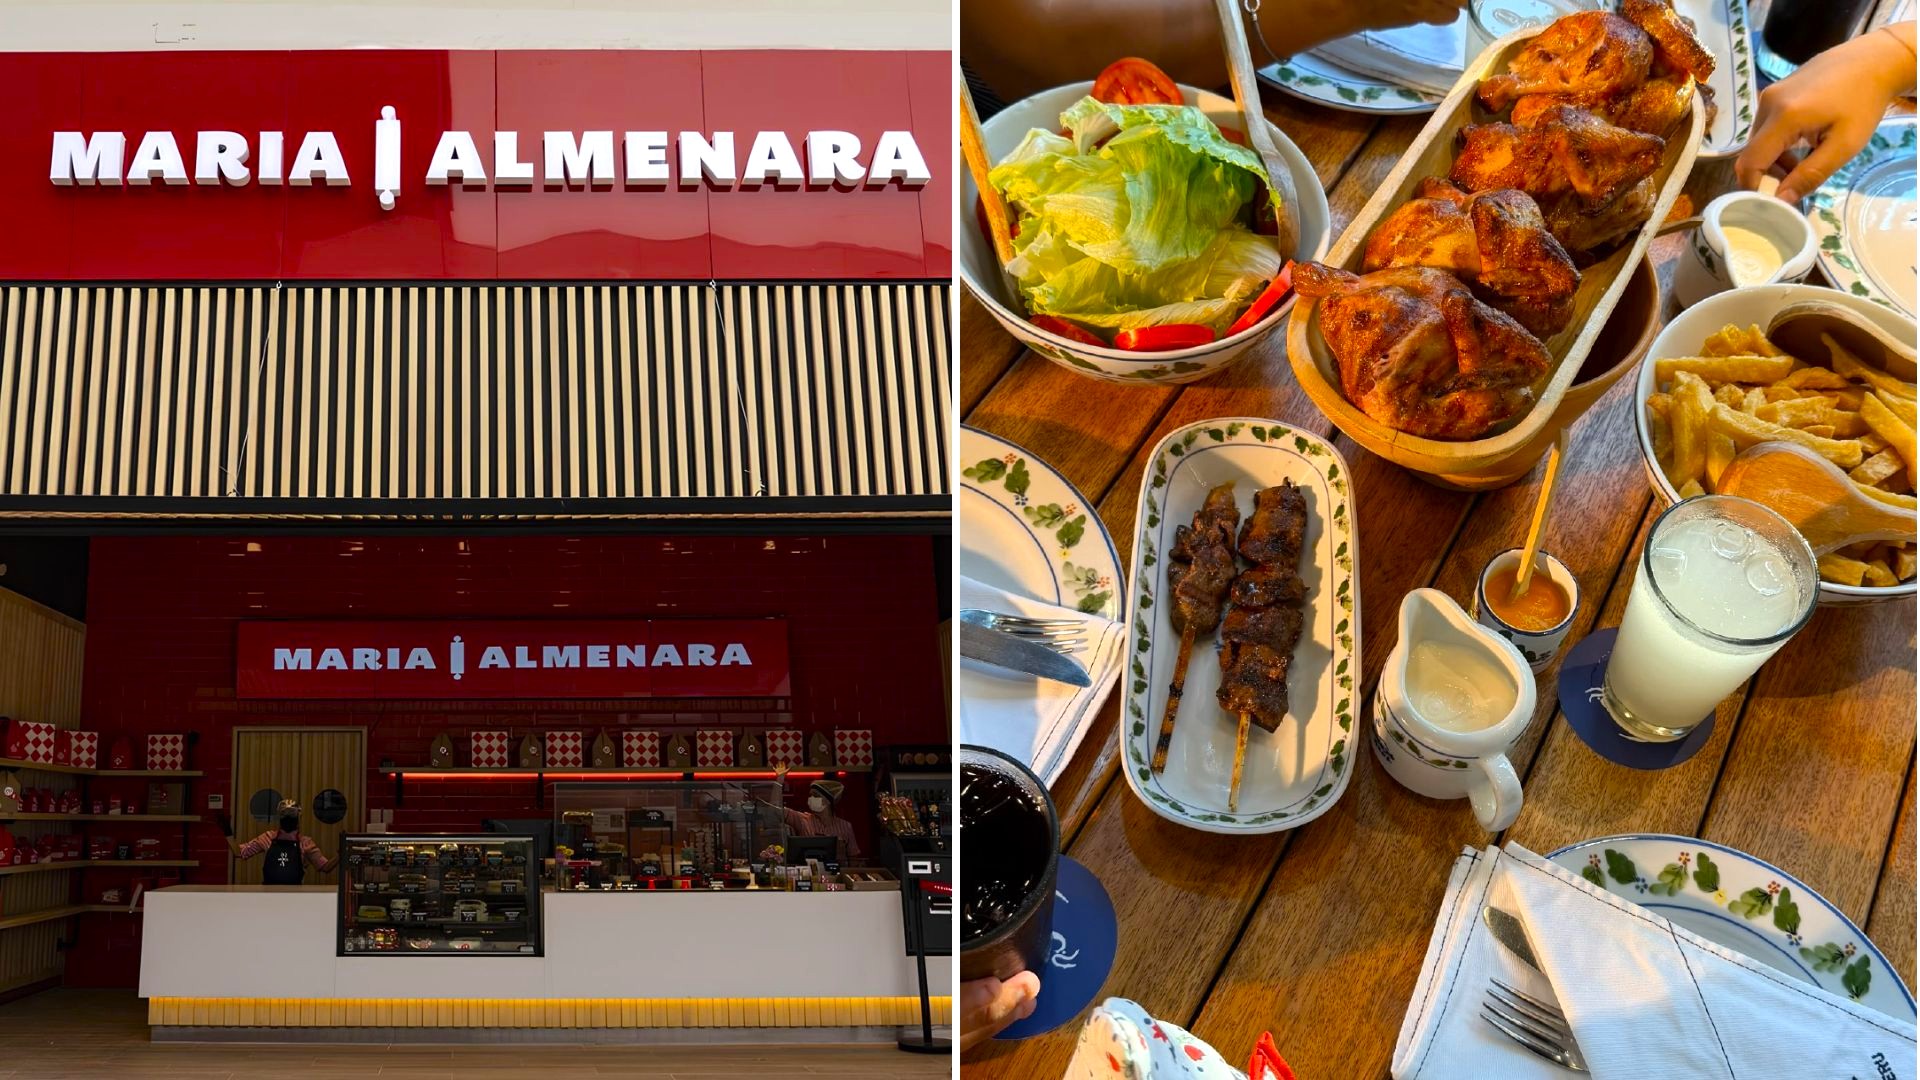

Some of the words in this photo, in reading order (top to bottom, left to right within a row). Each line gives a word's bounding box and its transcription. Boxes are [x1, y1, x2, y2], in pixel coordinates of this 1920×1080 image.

[50, 130, 352, 186] MARIA
[425, 130, 933, 187] ALMENARA
[274, 647, 437, 670] MARIA
[478, 643, 753, 669] ALMENARA
